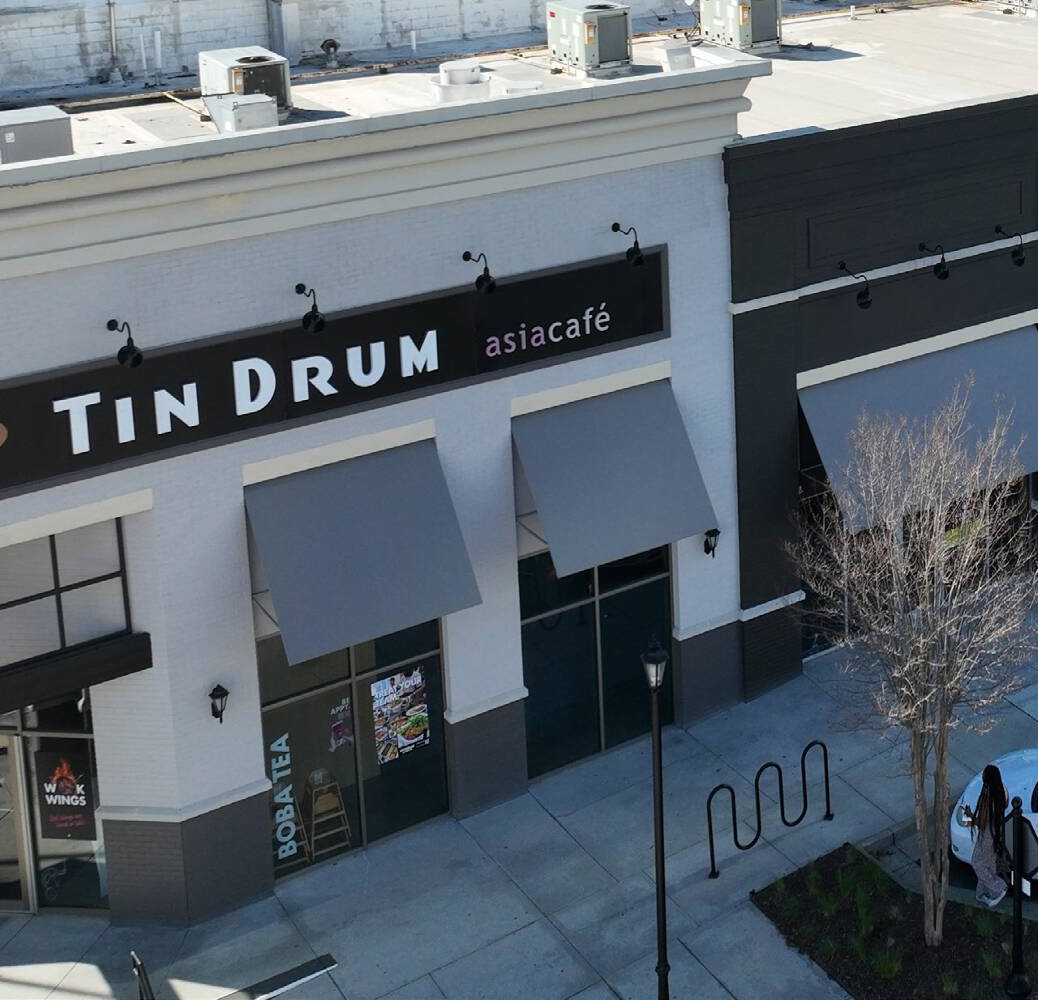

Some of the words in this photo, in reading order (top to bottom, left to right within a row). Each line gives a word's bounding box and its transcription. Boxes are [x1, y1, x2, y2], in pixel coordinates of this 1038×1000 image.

[53, 381, 200, 456] TIN
[233, 329, 440, 417] DRUM
[485, 303, 612, 358] asiacafé
[399, 677, 422, 690] YOUR
[270, 732, 292, 784] TEA
[45, 794, 87, 806] WINGS
[274, 784, 297, 860] BOBA
